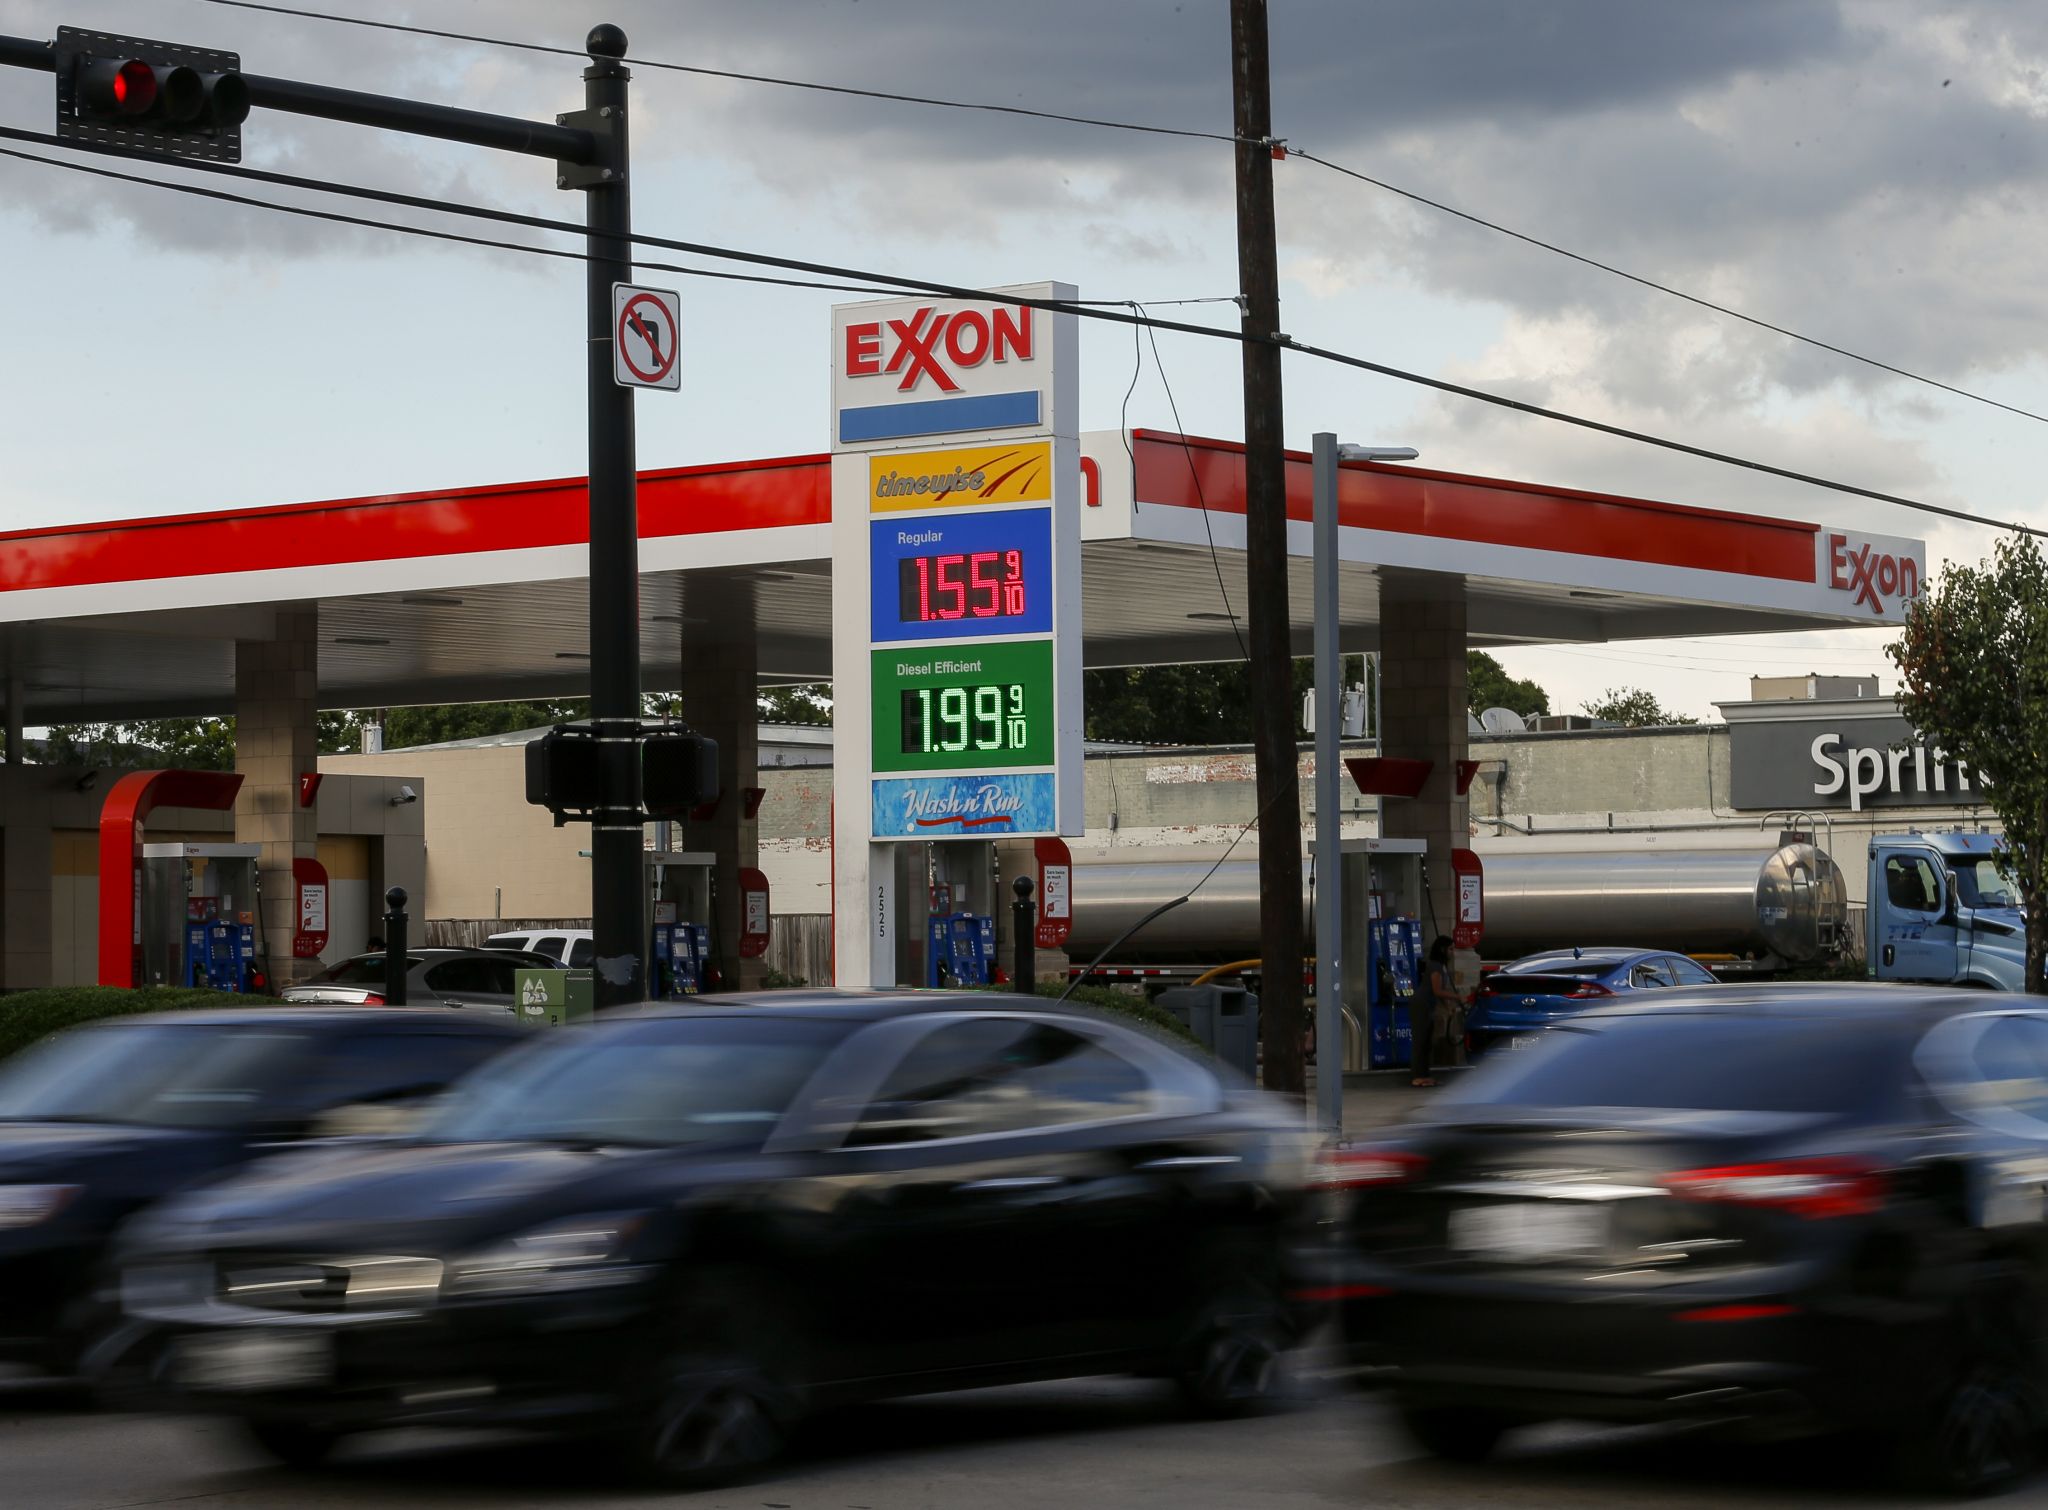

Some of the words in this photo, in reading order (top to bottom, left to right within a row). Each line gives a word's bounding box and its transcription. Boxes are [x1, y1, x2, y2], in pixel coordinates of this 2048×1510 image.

[846, 304, 1034, 393] EXXON
[876, 466, 986, 498] timewise
[897, 530, 943, 546] Regular
[915, 552, 1000, 621] 1.55
[1828, 532, 1918, 614] Exxon
[896, 662, 932, 676] Diesel
[934, 660, 982, 674] Efficient
[919, 686, 1002, 752] 1.99
[302, 778, 309, 789] 7
[903, 785, 961, 819] Wash
[977, 784, 1024, 815] Run
[1047, 881, 1054, 893] 6
[304, 898, 311, 909] 6
